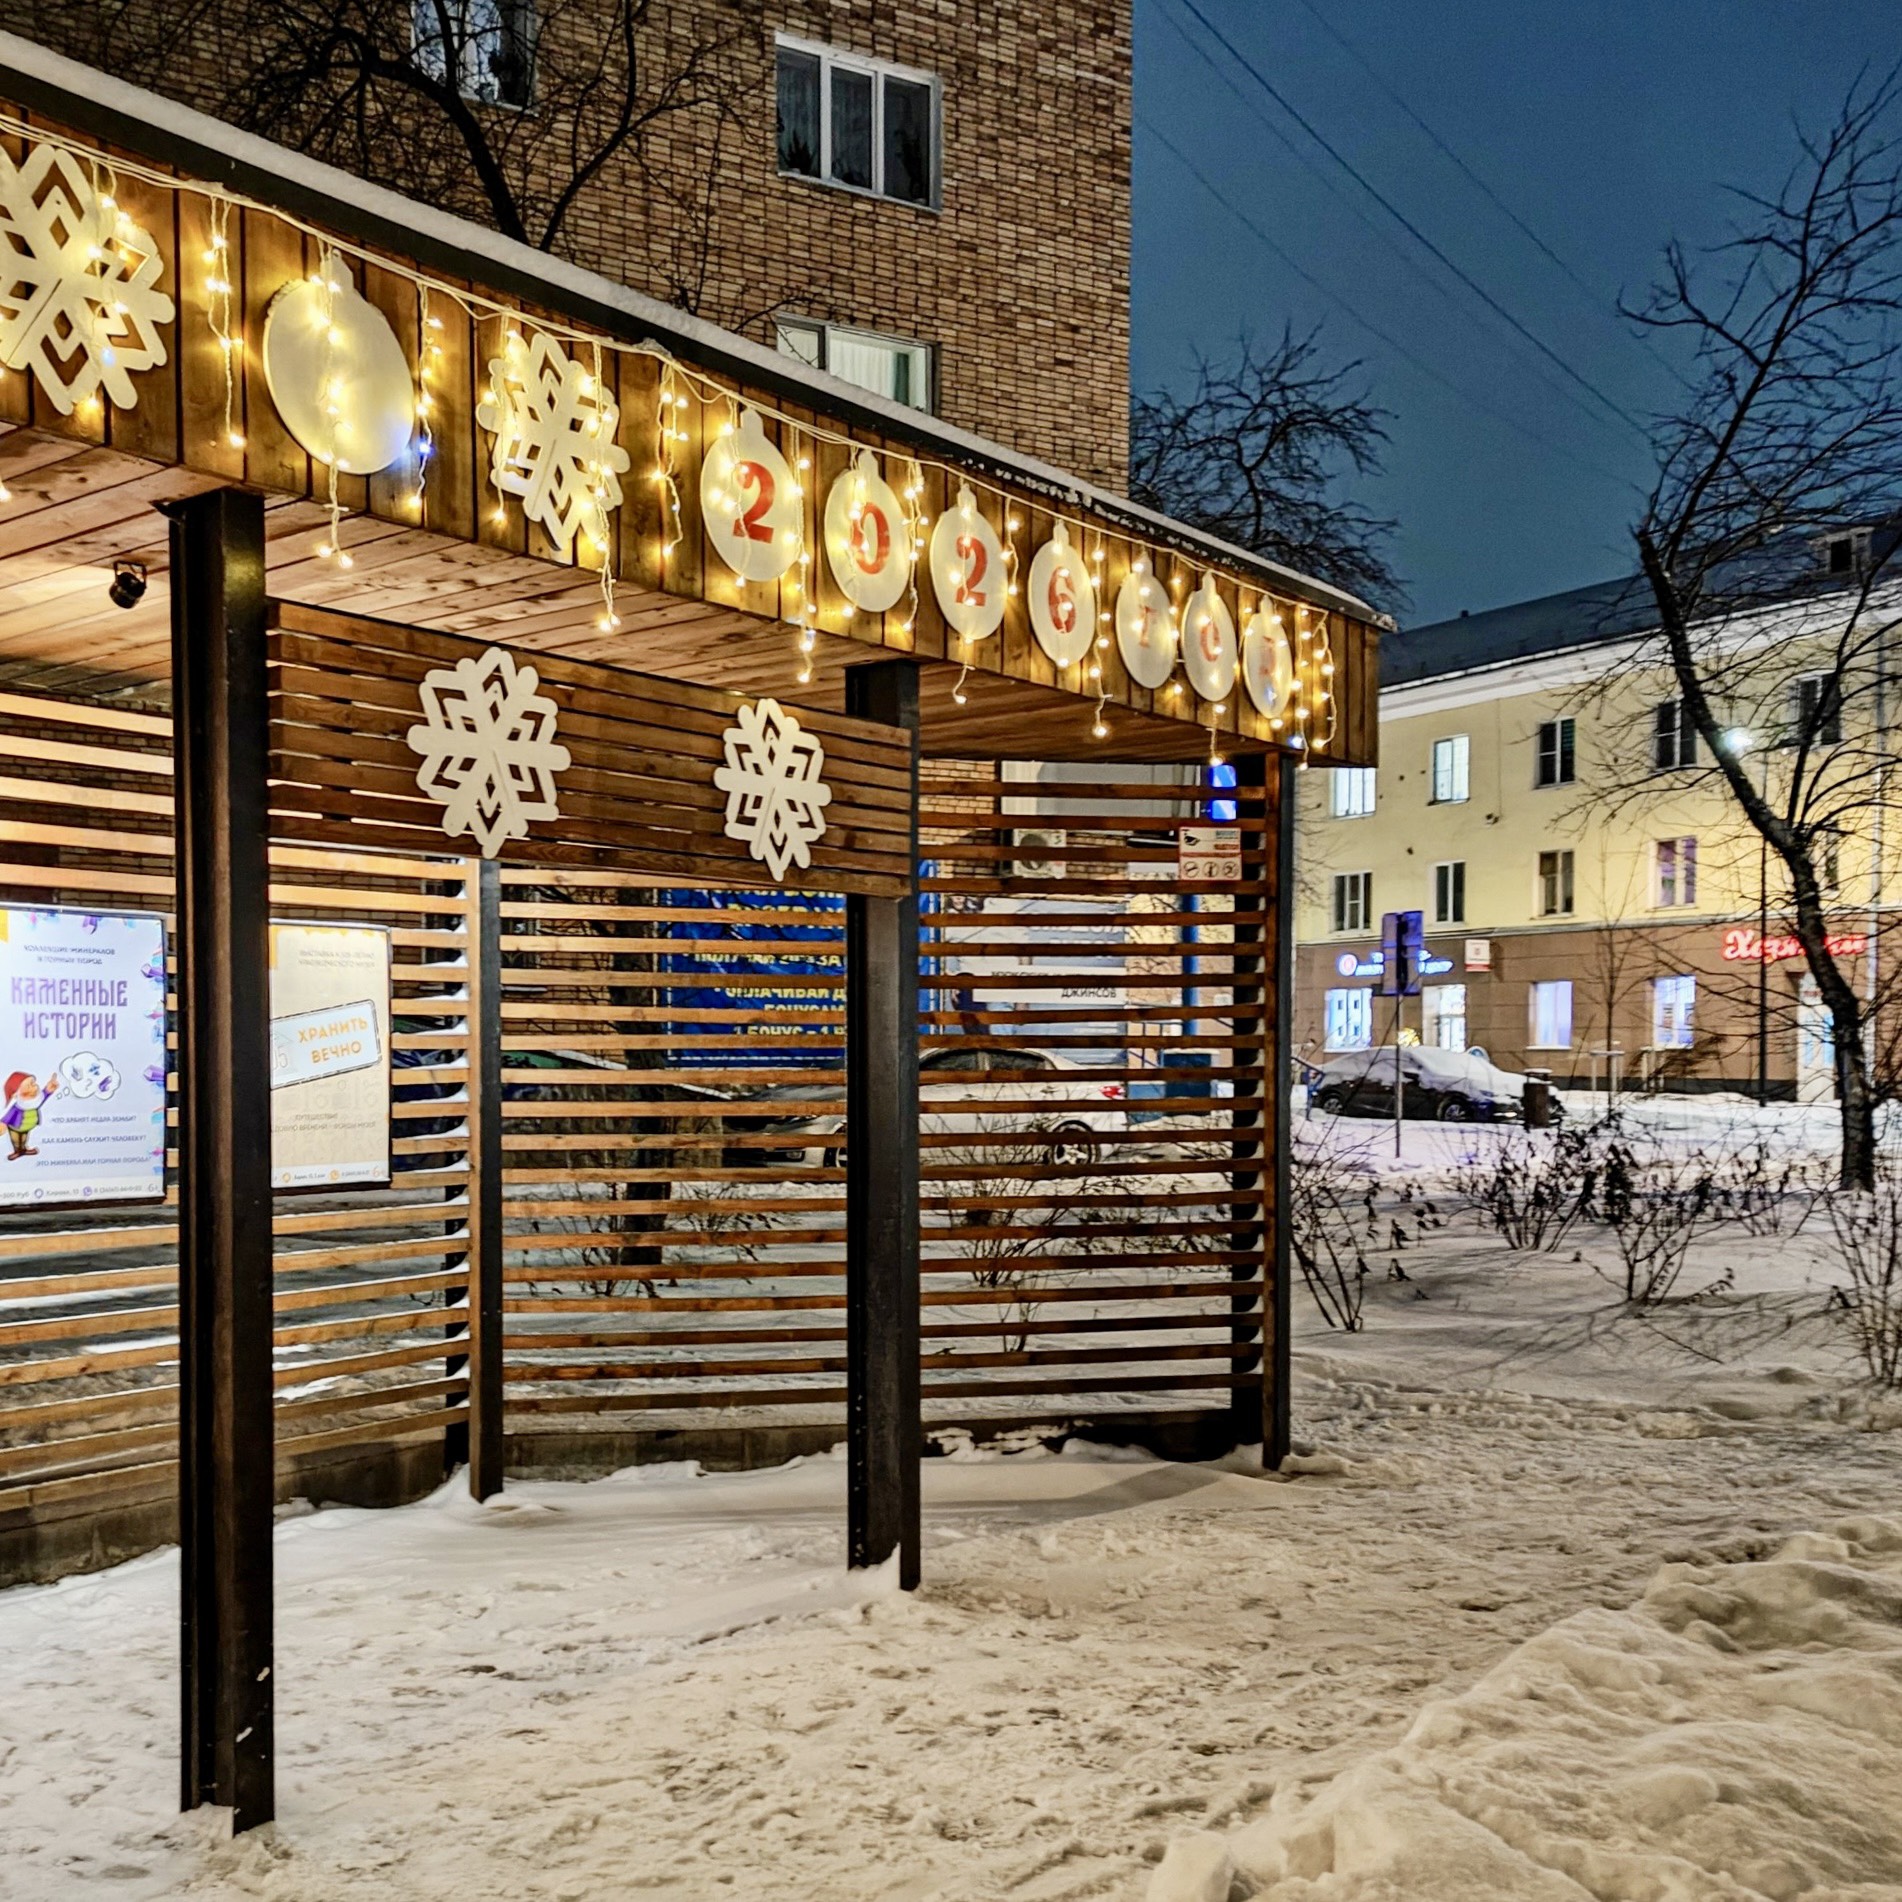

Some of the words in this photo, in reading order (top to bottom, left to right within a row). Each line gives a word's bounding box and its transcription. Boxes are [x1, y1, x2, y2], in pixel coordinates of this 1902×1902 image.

[11, 976, 128, 1007] КАМЕННЫЕ
[1061, 987, 1117, 998] ДЖИНСОВ
[24, 1012, 117, 1040] ИСТОРИИ
[298, 1017, 368, 1043] ХРАНИТЬ
[311, 1041, 362, 1063] ВЕЧНО
